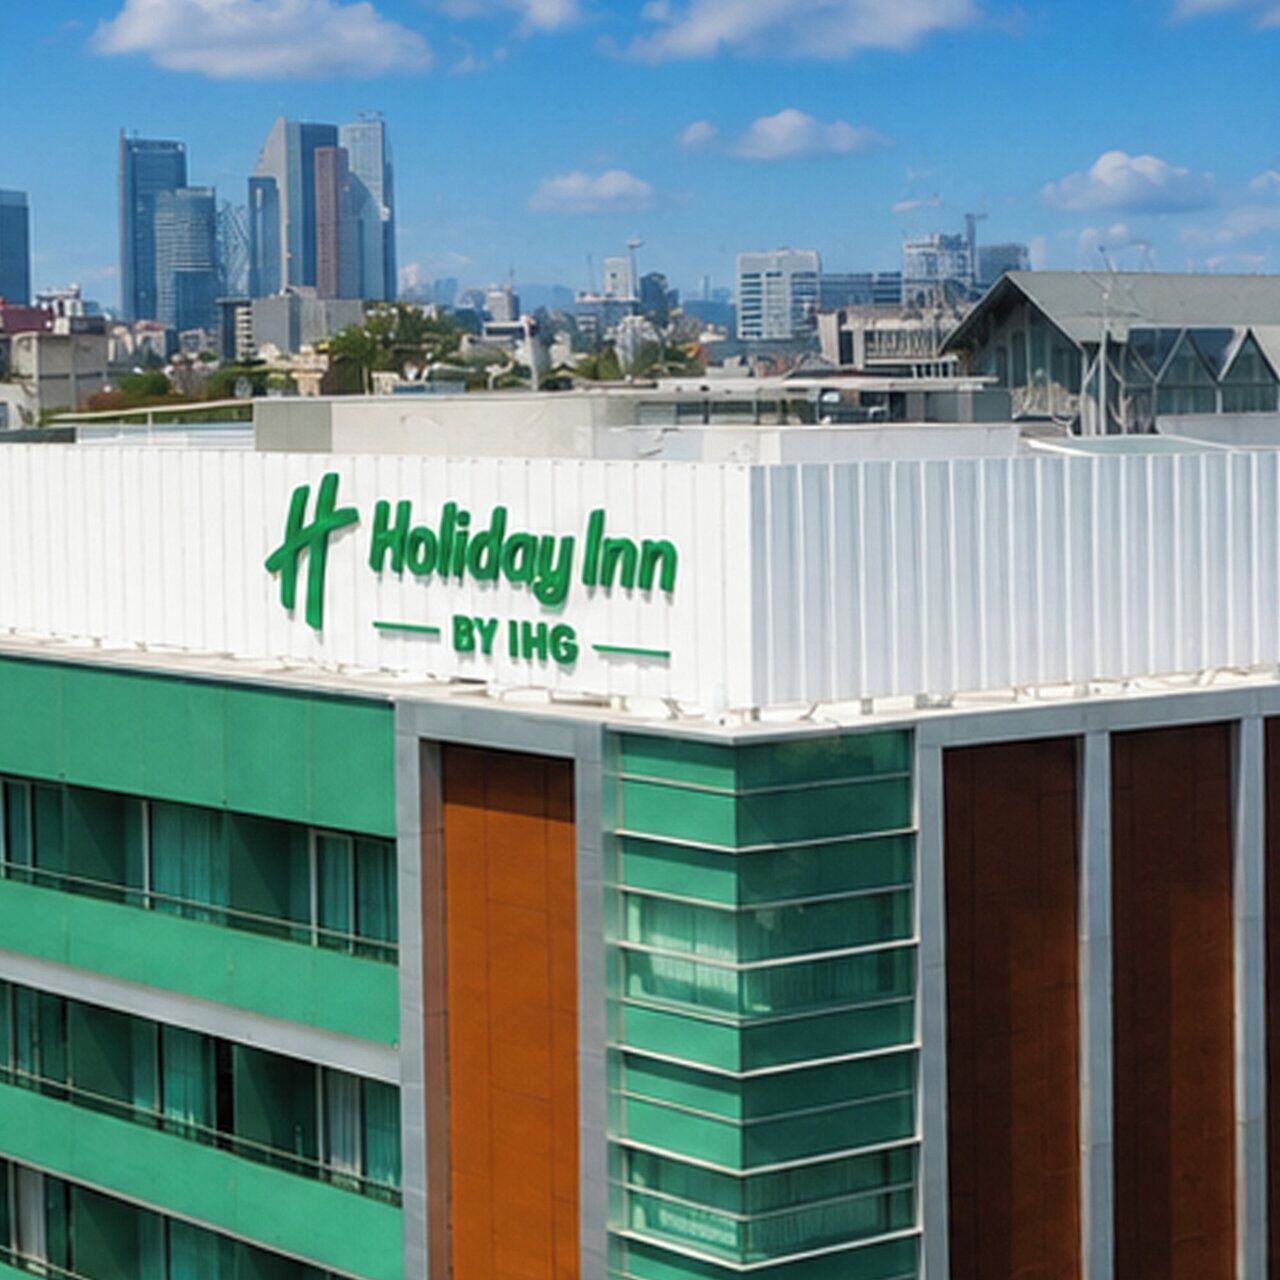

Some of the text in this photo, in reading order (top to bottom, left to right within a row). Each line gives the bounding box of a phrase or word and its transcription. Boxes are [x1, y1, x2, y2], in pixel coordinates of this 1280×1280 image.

[369, 500, 678, 606] Holiday Inn
[452, 615, 578, 664] BY IHG
